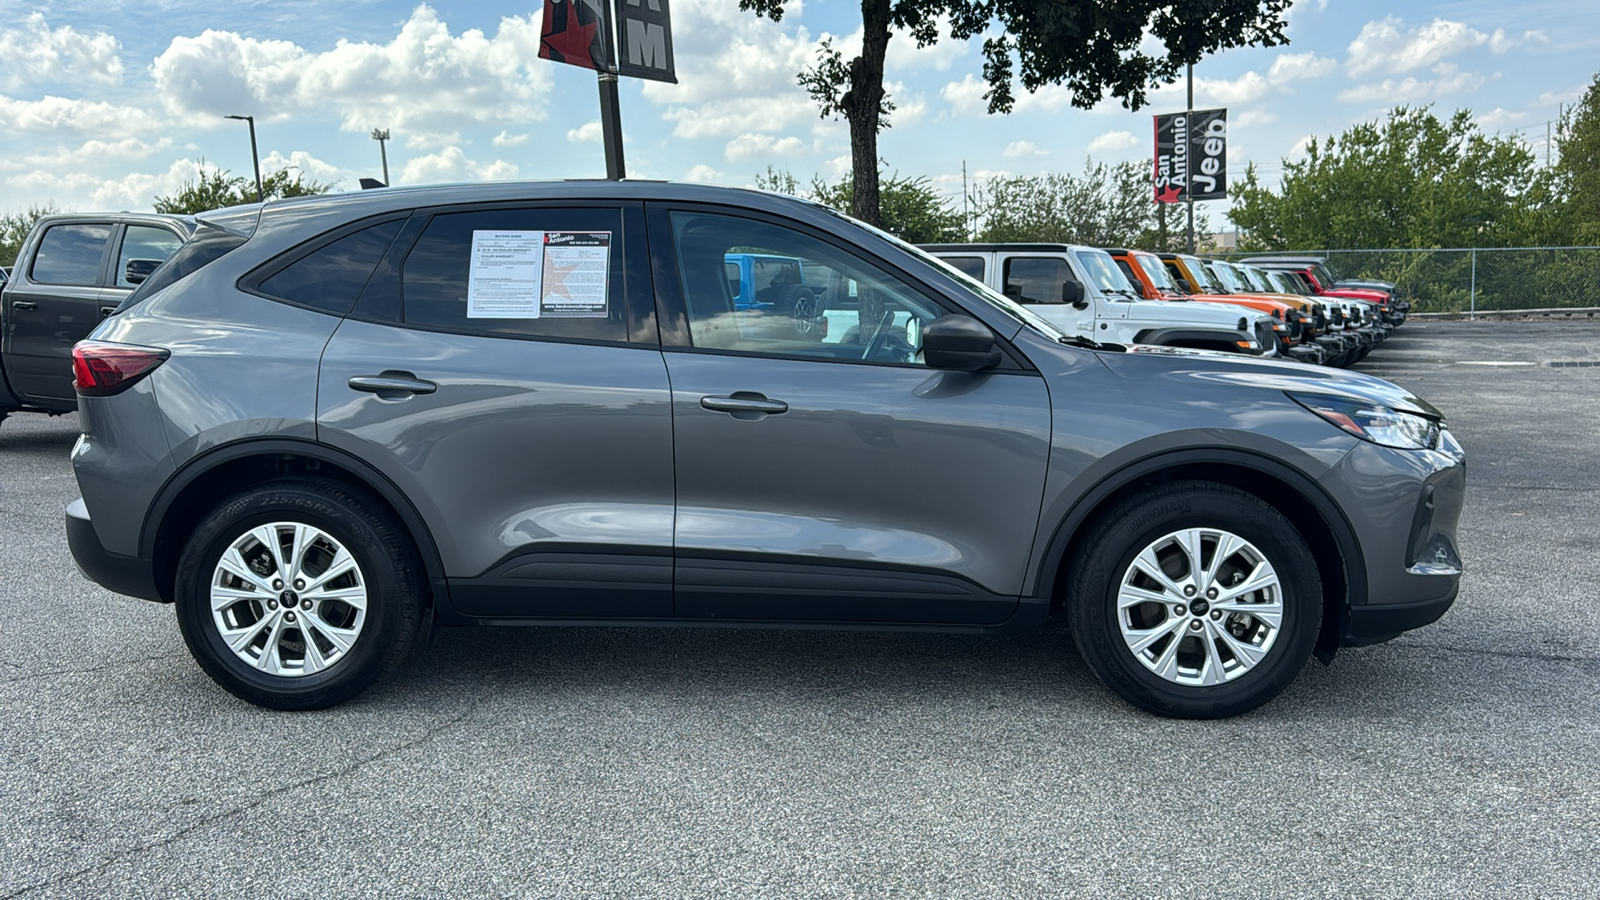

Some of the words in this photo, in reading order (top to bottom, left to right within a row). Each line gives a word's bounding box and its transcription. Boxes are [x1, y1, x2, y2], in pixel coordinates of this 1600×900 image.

[1170, 116, 1186, 187] Antonio
[1192, 119, 1226, 193] Jeep
[1155, 154, 1170, 189] San
[549, 235, 575, 244] Antonio
[260, 496, 342, 518] 225/65R17
